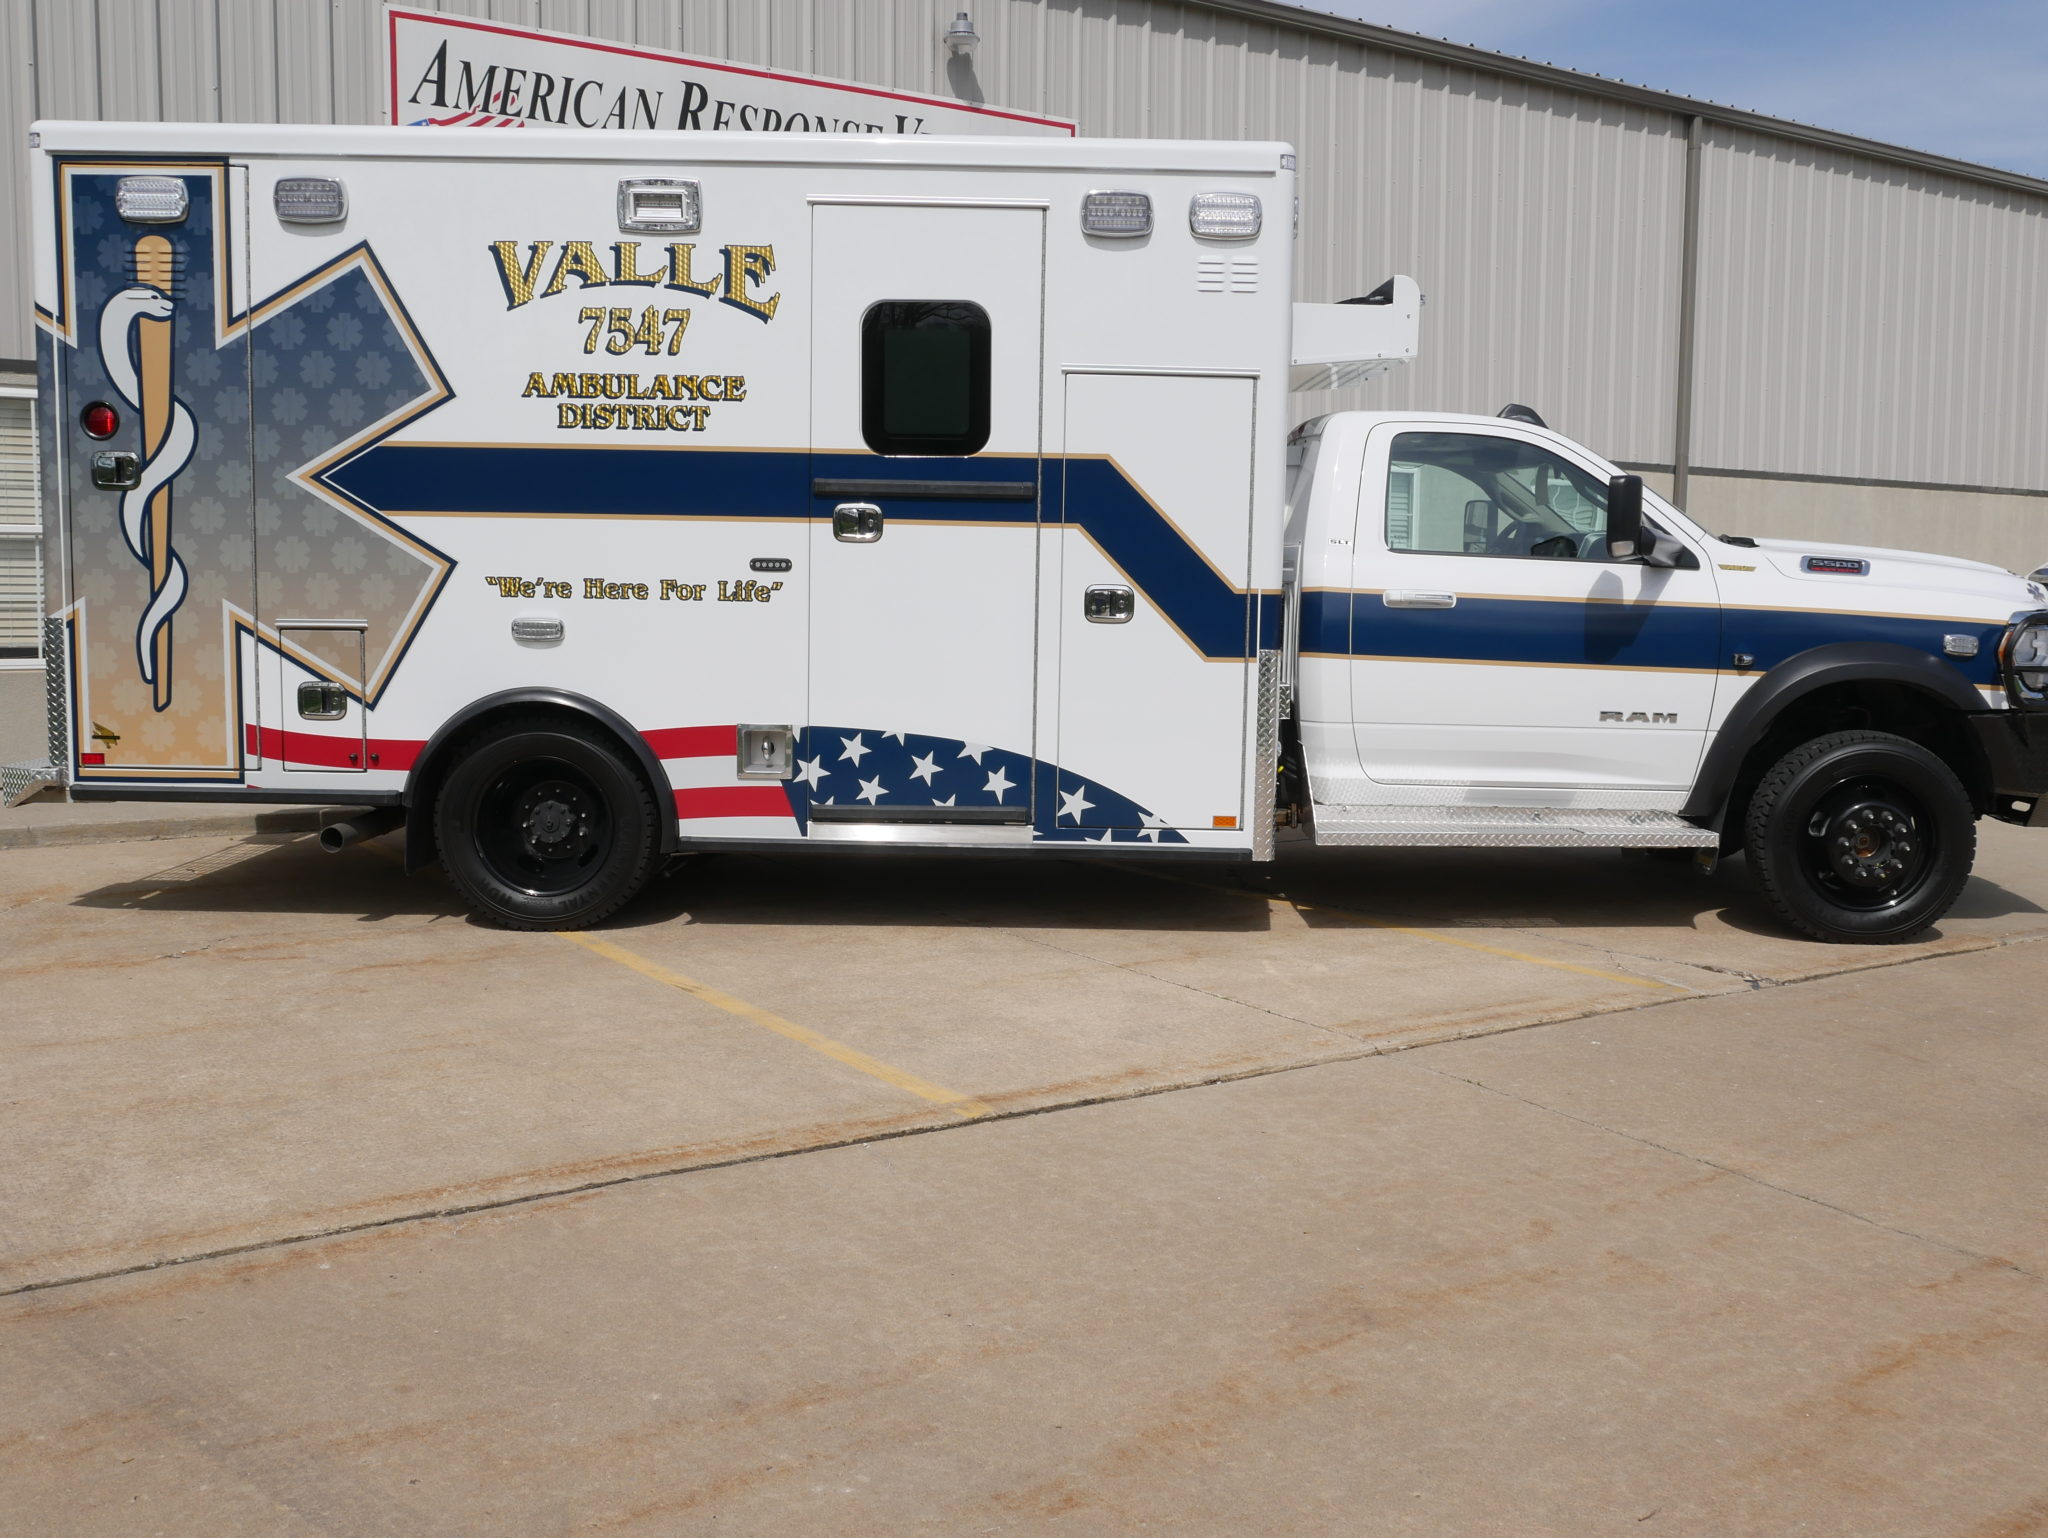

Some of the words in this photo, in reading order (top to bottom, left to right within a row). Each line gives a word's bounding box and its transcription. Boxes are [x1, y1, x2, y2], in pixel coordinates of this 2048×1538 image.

[408, 39, 664, 130] AMERICAN
[488, 240, 781, 324] VALLE
[578, 305, 691, 356] 7547
[521, 372, 747, 402] AMBULANCE
[557, 403, 711, 431] DISTRICT
[583, 577, 649, 600] Here
[659, 579, 707, 601] For
[717, 580, 784, 603] Life"
[1599, 711, 1678, 724] RAM
